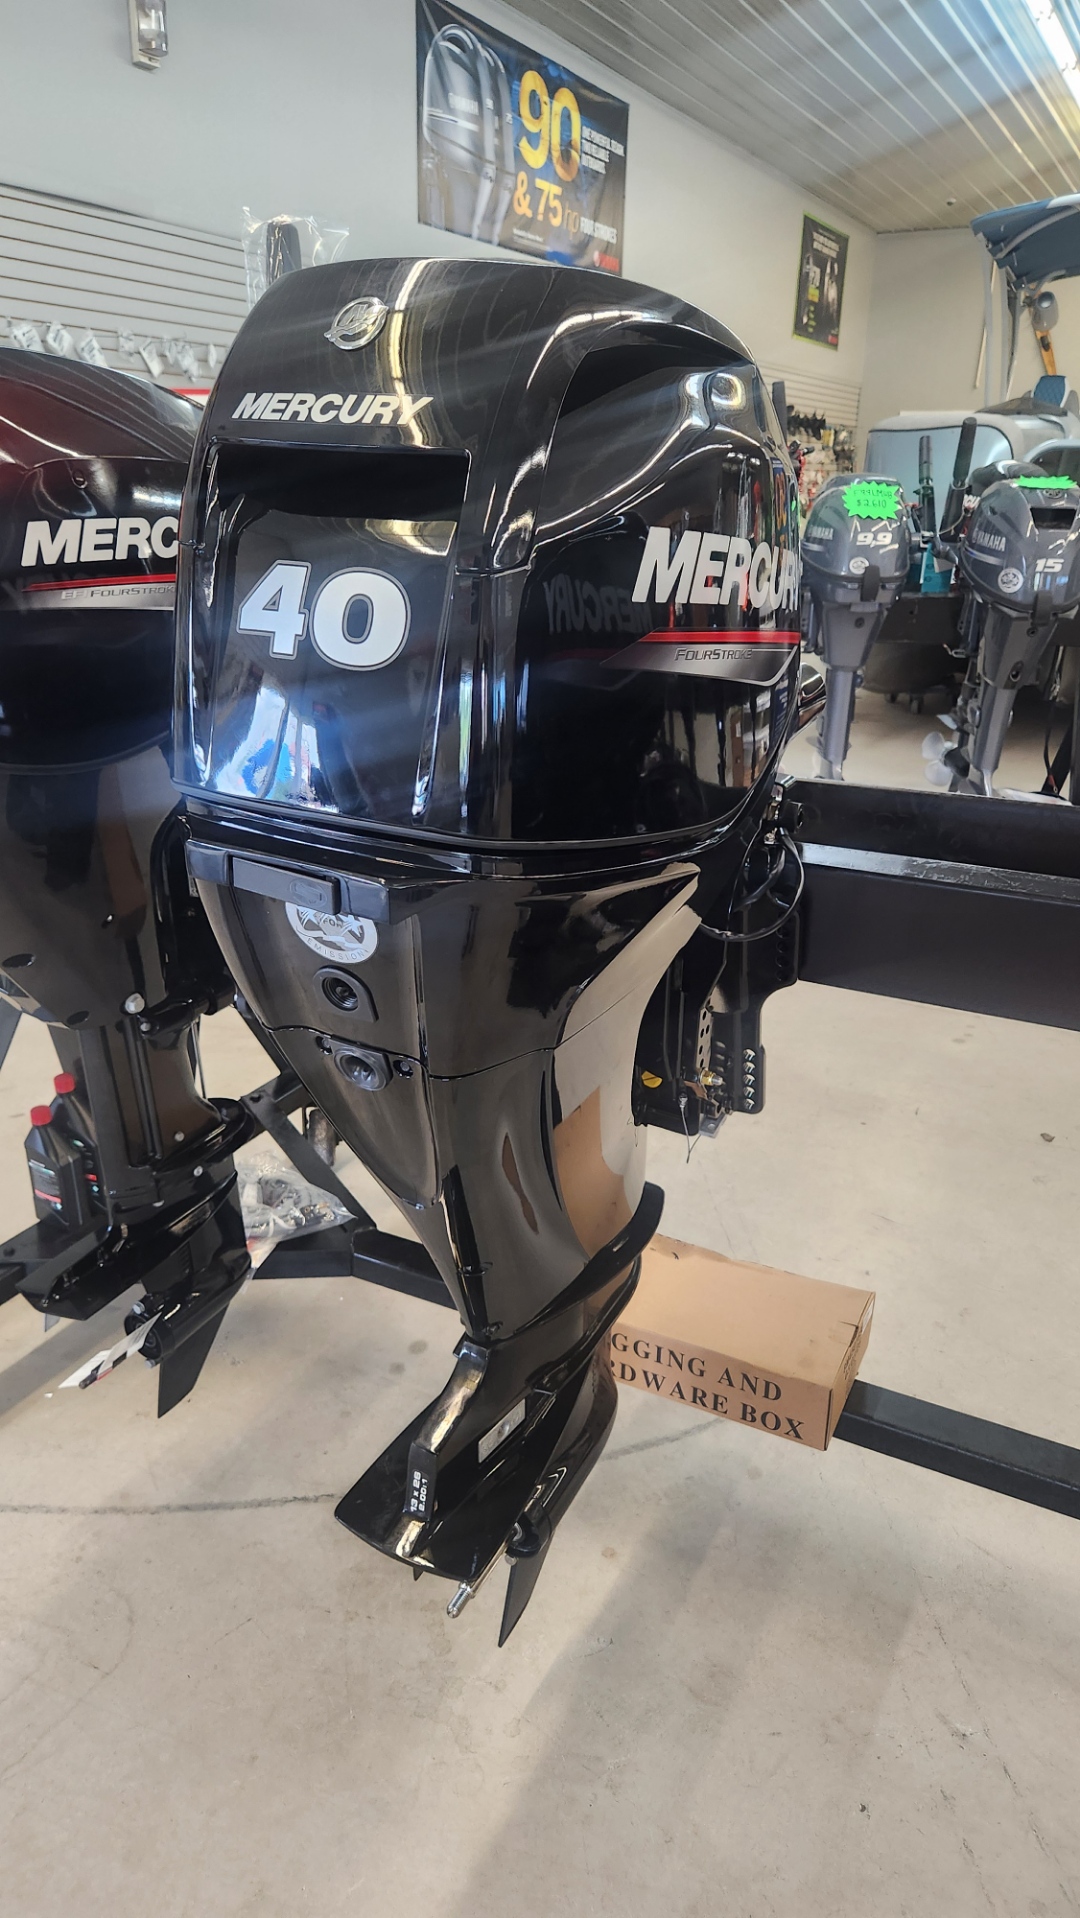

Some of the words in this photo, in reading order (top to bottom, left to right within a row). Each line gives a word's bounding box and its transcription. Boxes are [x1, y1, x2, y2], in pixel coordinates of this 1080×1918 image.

[519, 70, 581, 182] 90
[514, 172, 533, 220] &
[535, 180, 562, 227] 75
[565, 202, 579, 240] hp
[232, 392, 434, 426] MERCURY
[21, 516, 178, 567] MERC
[976, 533, 1006, 552] YAMAHA
[1035, 558, 1064, 573] 15
[236, 559, 410, 670] 40
[611, 1332, 705, 1377] GGING
[718, 1367, 782, 1401] AND
[741, 1402, 805, 1440] BOX
